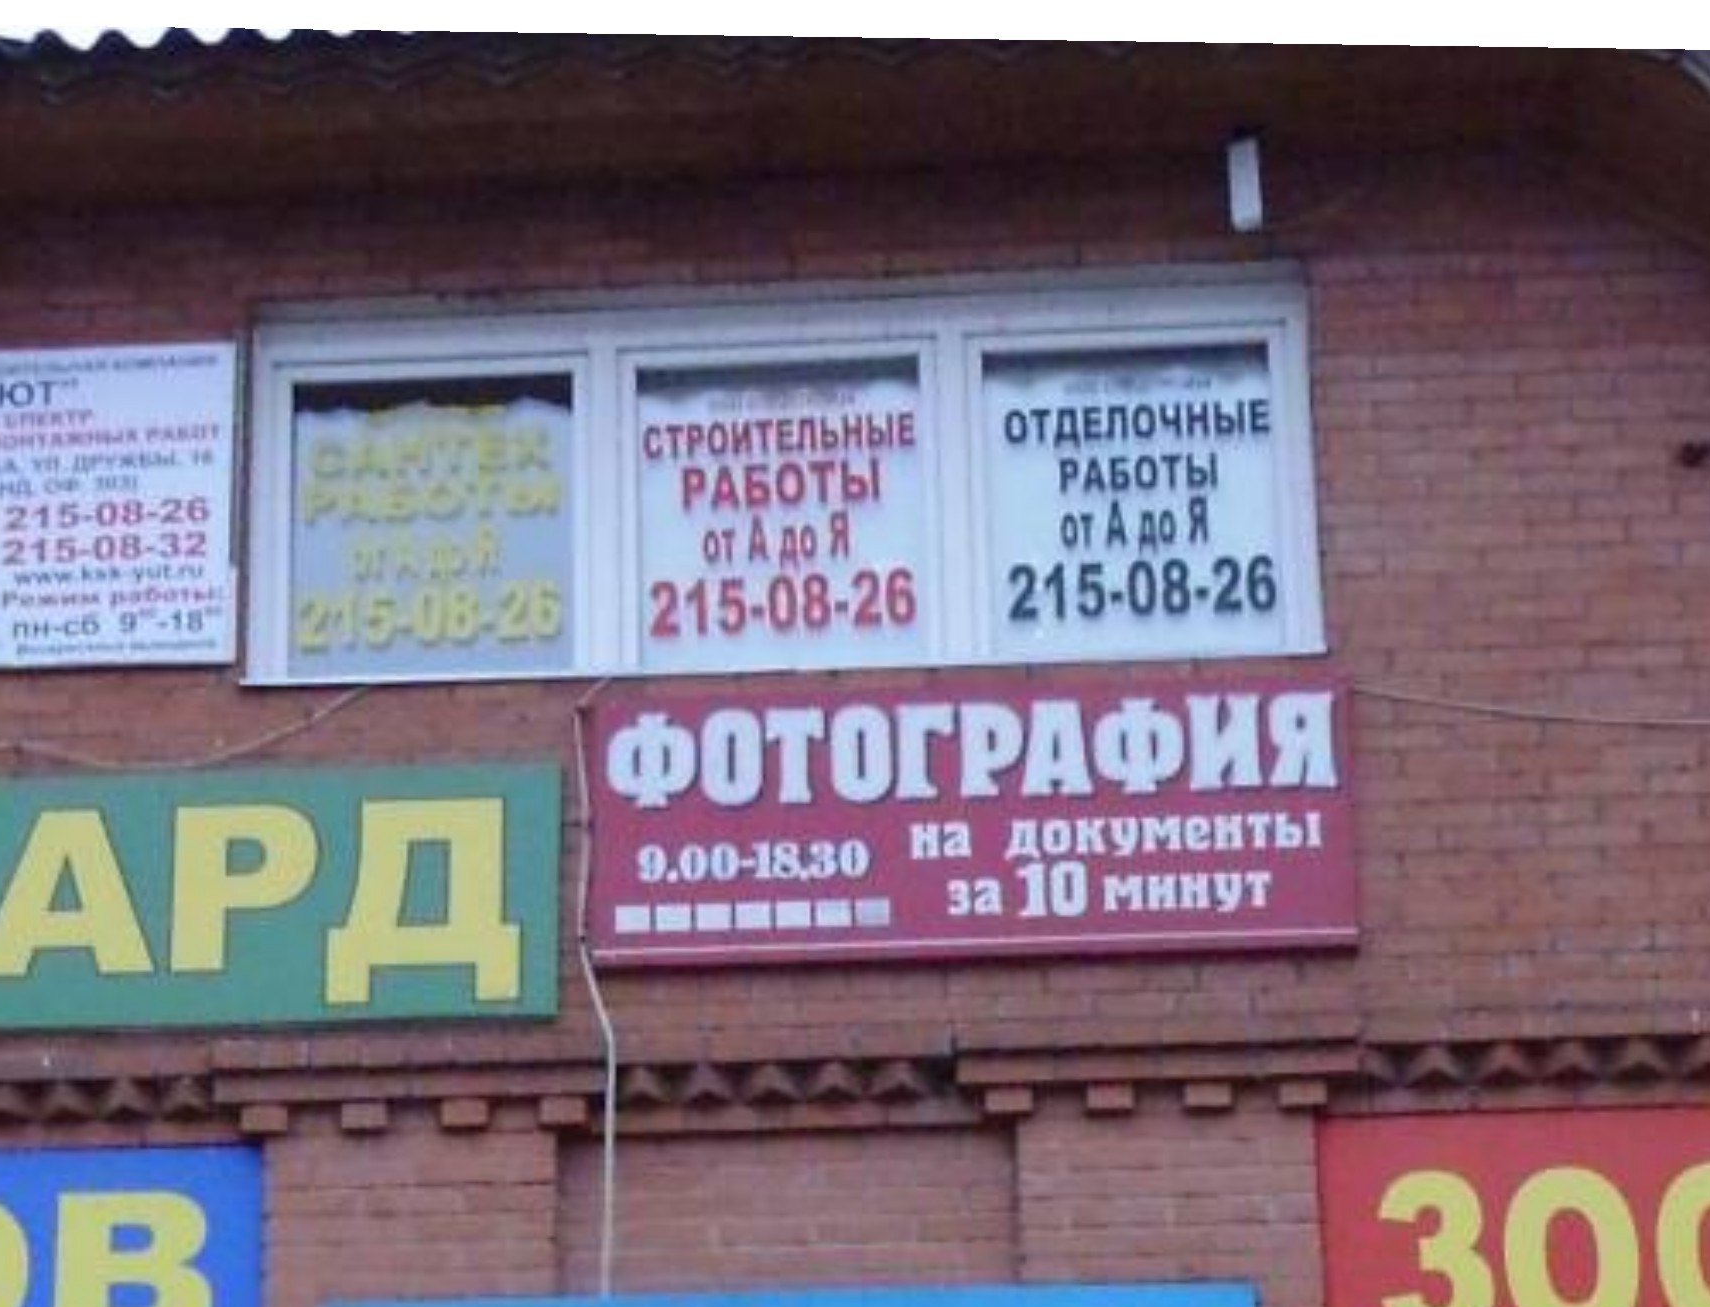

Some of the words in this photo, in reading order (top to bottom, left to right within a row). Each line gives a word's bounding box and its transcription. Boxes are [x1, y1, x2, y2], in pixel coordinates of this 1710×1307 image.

[642, 412, 917, 461] СТРОИТЕЛЬНЫЕ
[1004, 399, 1271, 450] ОТДЕЛОЧНЫЕ
[681, 457, 881, 513] РАБОТЫ
[1059, 453, 1218, 494] РАБОТЫ
[5, 497, 210, 533] 215-08-26
[703, 528, 735, 563] от
[748, 515, 769, 561] А
[779, 526, 817, 567] до
[830, 511, 850, 558] Я
[1060, 512, 1094, 549] от
[1106, 499, 1127, 547] А
[1138, 509, 1177, 553] до
[1188, 495, 1209, 543] Я
[2, 531, 207, 567] 215-08-32
[649, 567, 918, 638] 215-08-26
[1008, 554, 1278, 621] 215-08-26
[295, 579, 562, 654] 215-08-26
[605, 690, 1339, 810] ФОТОГРАФИЯ
[636, 840, 870, 884] 9.00-18.30
[909, 821, 971, 861] на
[1004, 811, 1323, 863] документы
[947, 876, 1003, 917] за
[1017, 861, 1087, 919] 10
[1104, 868, 1272, 913] минут
